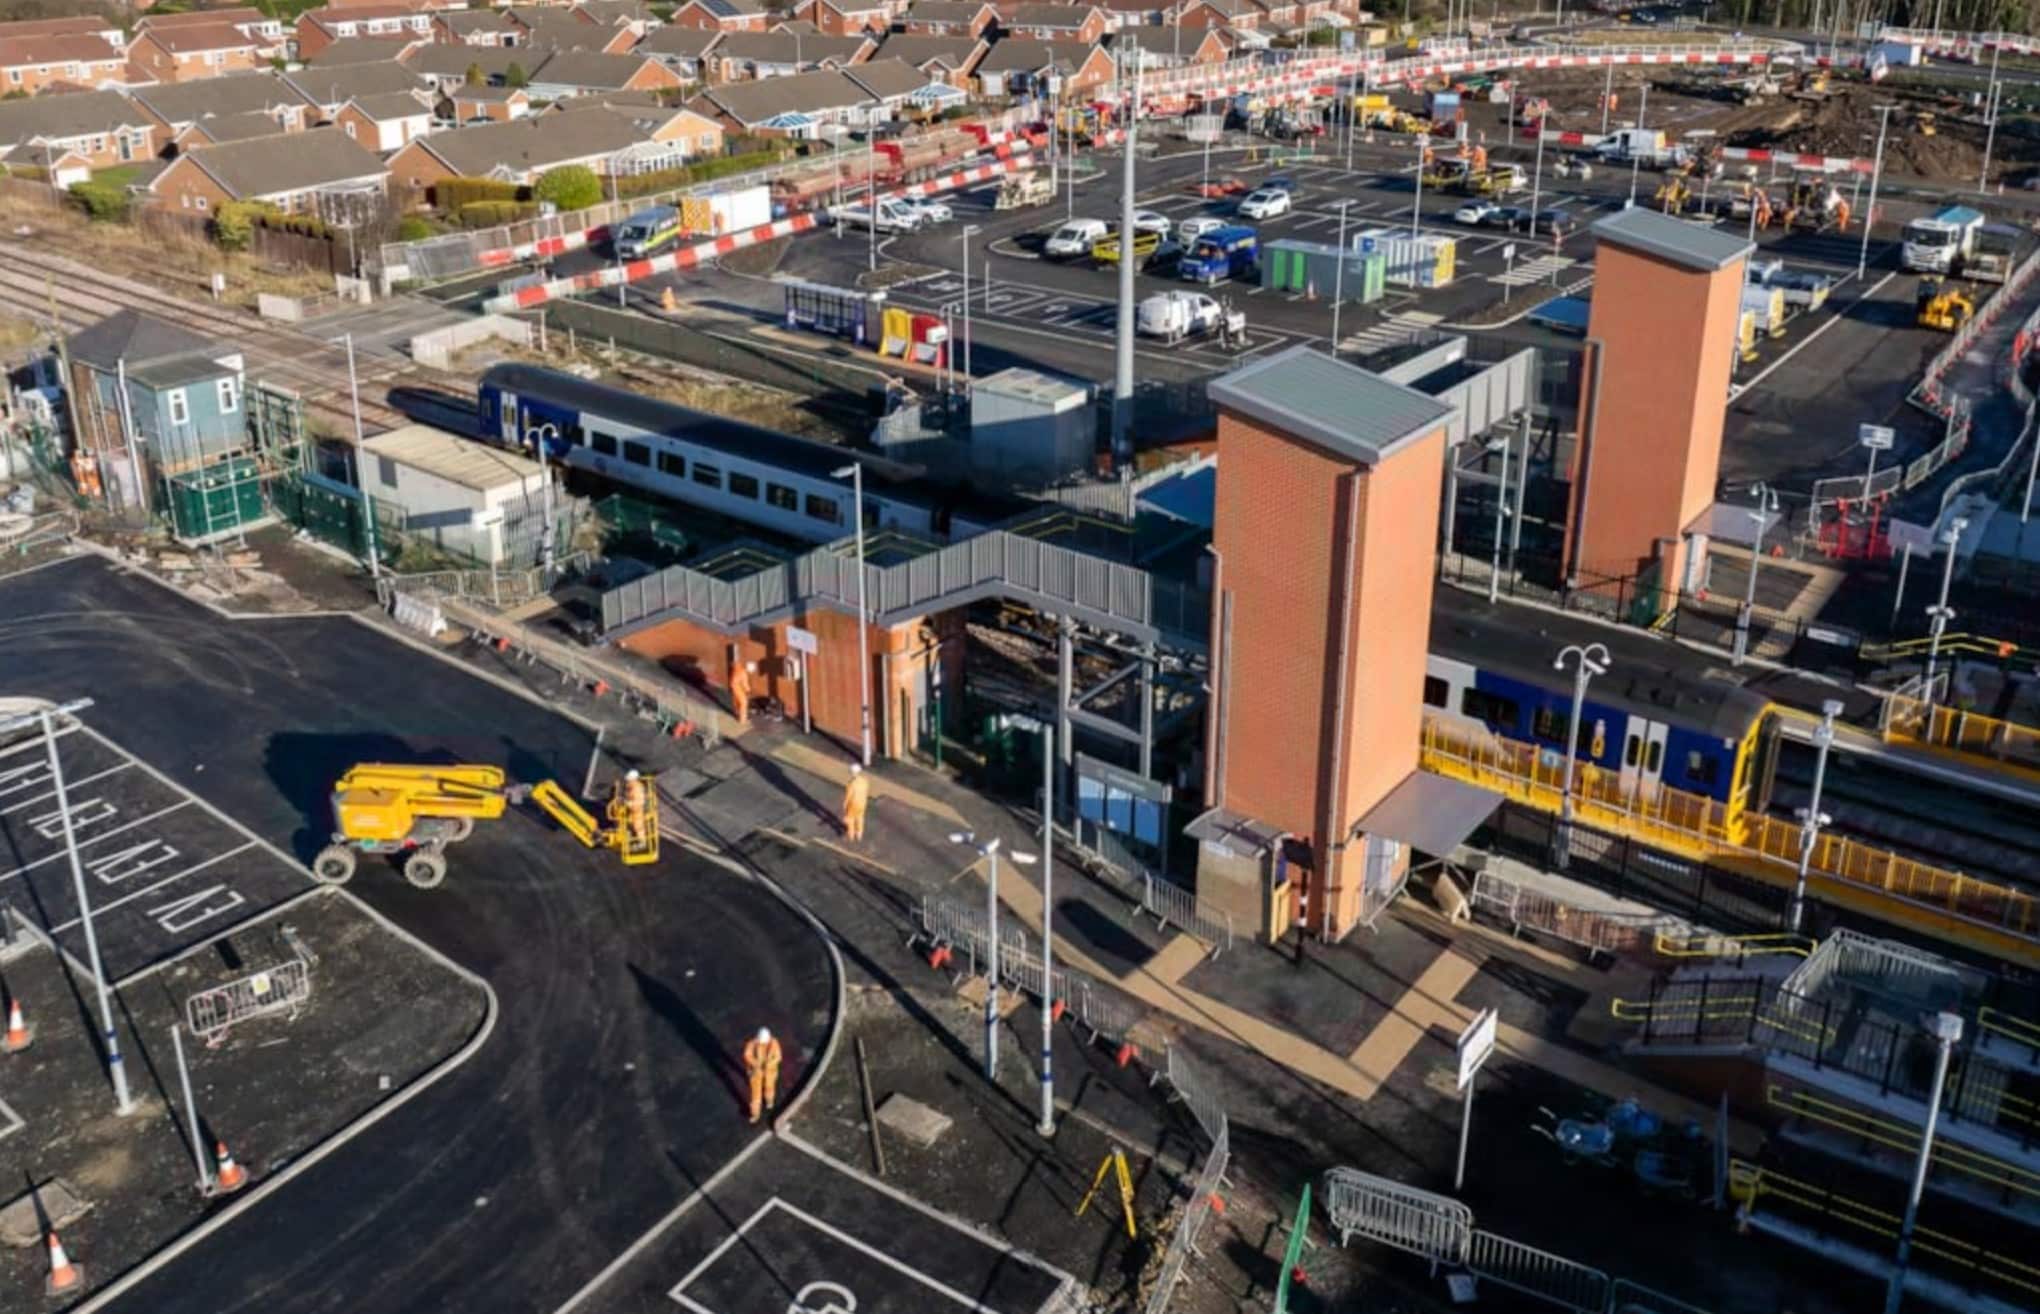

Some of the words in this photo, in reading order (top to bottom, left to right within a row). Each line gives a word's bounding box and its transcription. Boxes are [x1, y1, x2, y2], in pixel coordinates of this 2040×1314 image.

[27, 798, 118, 839] EV
[84, 839, 180, 885] EV
[146, 884, 246, 933] EV
